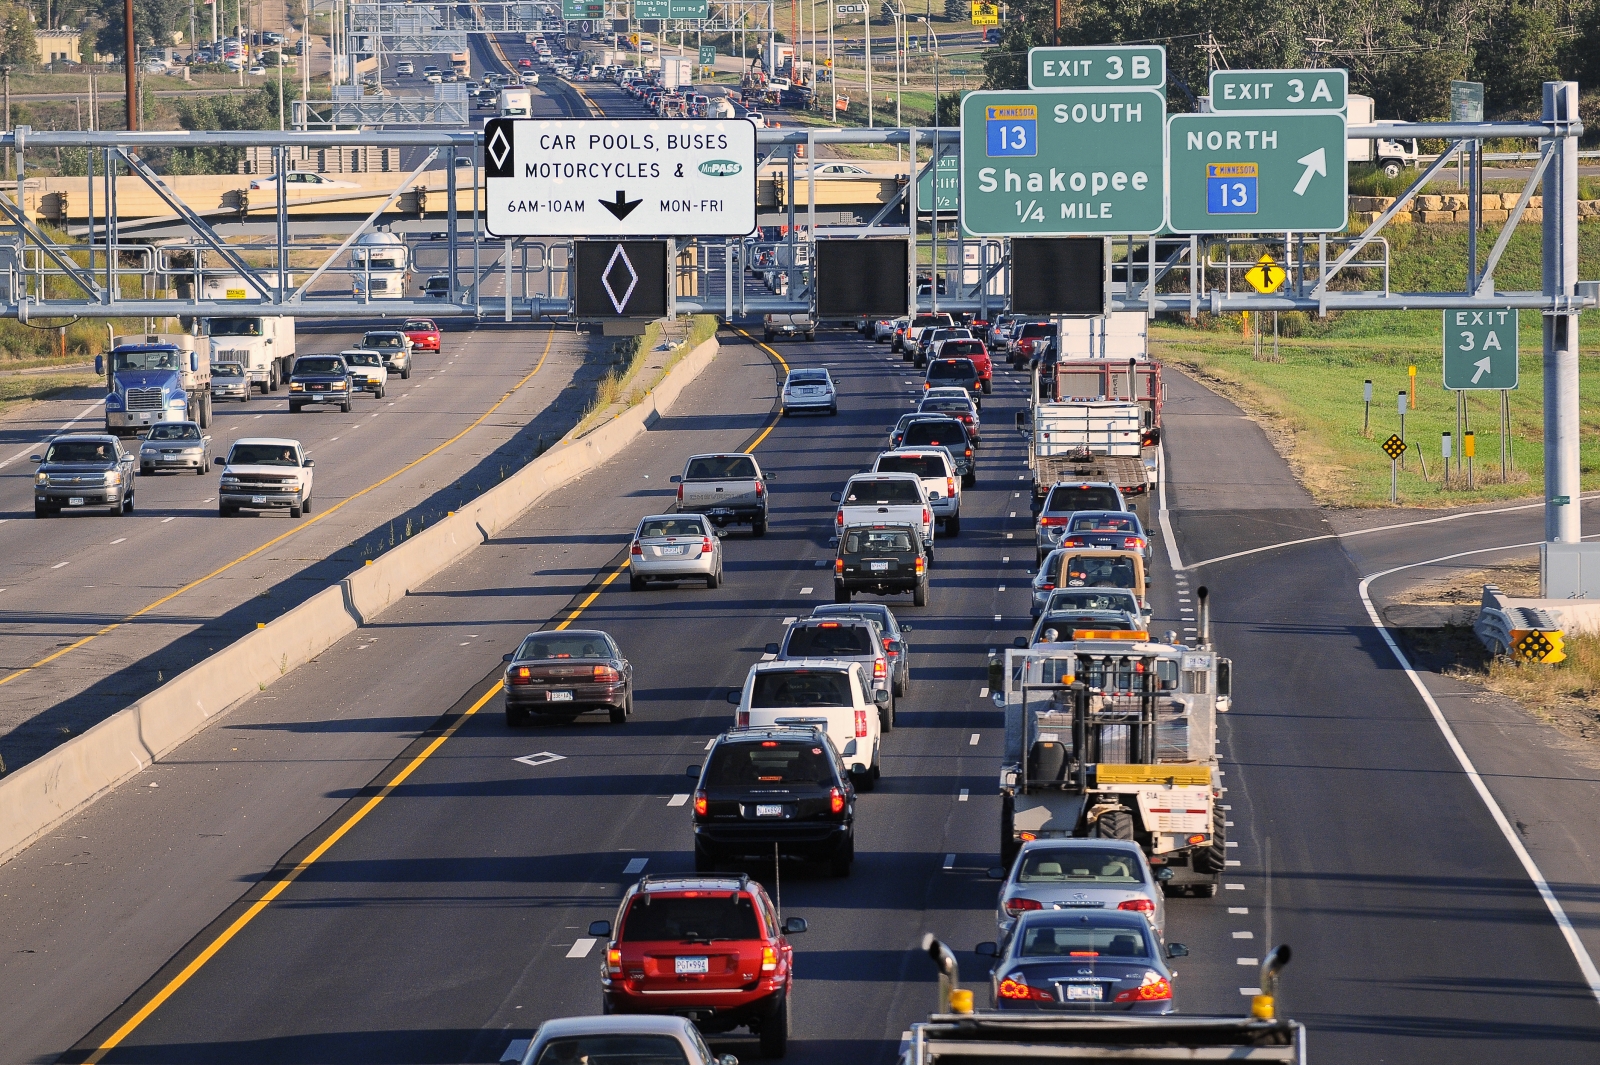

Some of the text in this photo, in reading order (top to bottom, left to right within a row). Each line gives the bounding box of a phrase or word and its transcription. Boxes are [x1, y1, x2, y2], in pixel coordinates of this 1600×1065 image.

[1043, 60, 1093, 77] EXIT
[1223, 83, 1274, 100] EXIT
[999, 107, 1035, 117] MINNESOTA
[1053, 103, 1142, 124] SOUTH
[539, 134, 728, 152] CAR POOLS, BUSES
[999, 126, 1027, 150] 13
[1187, 130, 1278, 151] NORTH
[525, 162, 740, 179] MOTORCYCLES & MnPASS
[1219, 165, 1256, 175] MINNESOTA
[978, 167, 1148, 197] Shakopee
[1220, 182, 1248, 207] 13
[507, 199, 723, 213] 6AM-10AM MON-FRI
[1015, 199, 1113, 223] 1/4 MILE
[1456, 311, 1509, 326] EXIT
